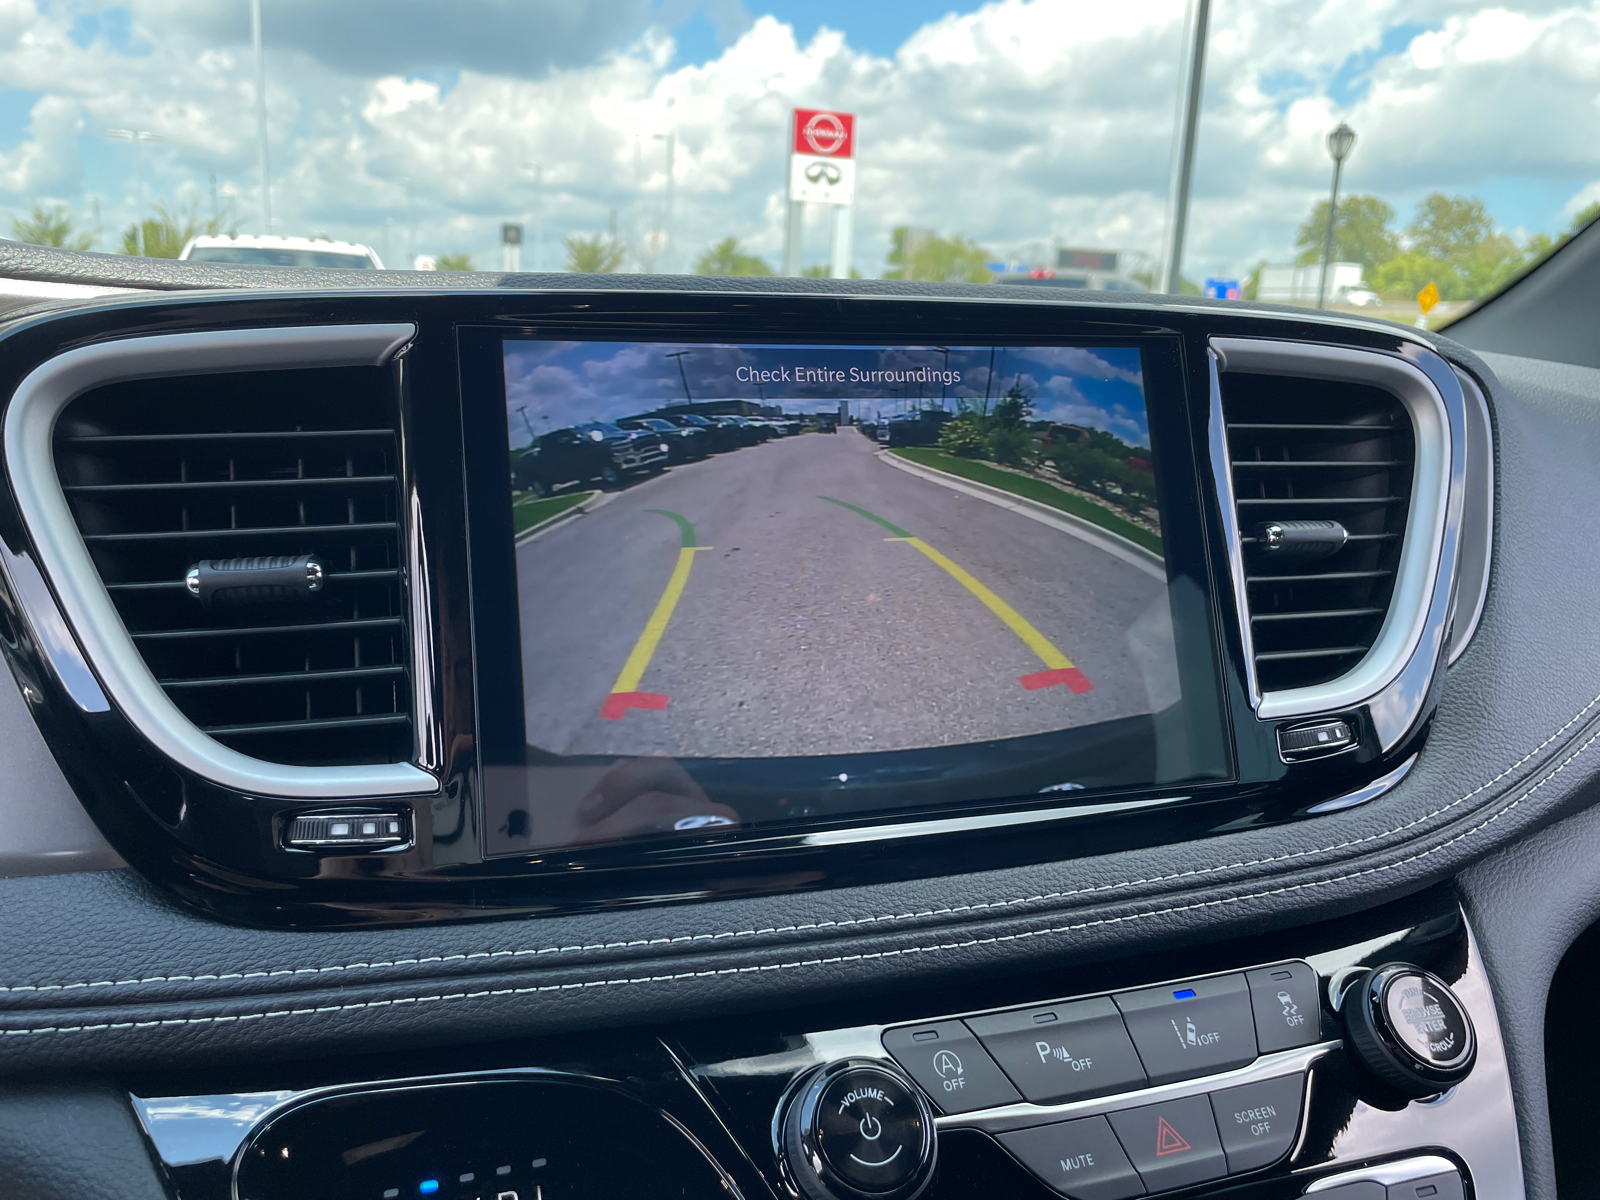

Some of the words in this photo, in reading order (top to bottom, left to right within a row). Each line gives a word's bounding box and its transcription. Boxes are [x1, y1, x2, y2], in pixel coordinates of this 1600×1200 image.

[735, 366, 791, 382] Check
[794, 367, 846, 383] Entire
[849, 367, 961, 386] Surroundings
[1402, 1004, 1443, 1018] BROWSE
[1286, 1015, 1304, 1027] OFF
[1414, 1020, 1447, 1034] ENTER
[1201, 1031, 1220, 1046] OFF
[1425, 1037, 1455, 1052] SCROLL
[1071, 1057, 1092, 1072] OFF
[943, 1077, 965, 1092] OFF
[841, 1087, 885, 1107] VOLUME
[1234, 1105, 1277, 1124] SCREEN
[1250, 1121, 1271, 1136] OFF
[1060, 1153, 1095, 1172] MUTE
